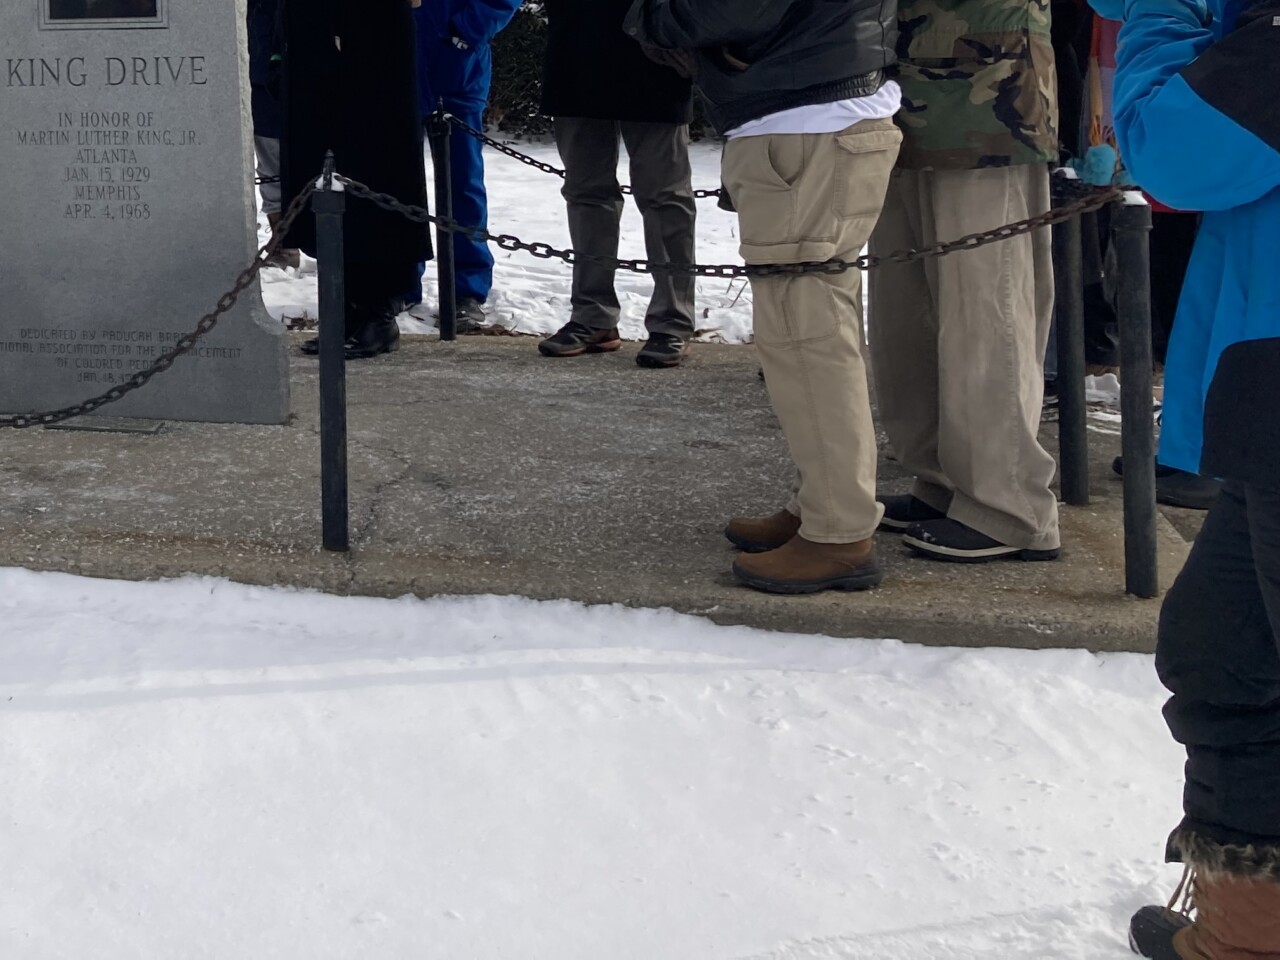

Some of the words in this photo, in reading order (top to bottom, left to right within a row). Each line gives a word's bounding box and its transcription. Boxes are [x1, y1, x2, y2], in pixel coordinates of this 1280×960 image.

[6, 57, 88, 87] KING
[104, 56, 208, 86] DRIVE
[58, 111, 73, 127] IN
[80, 111, 131, 128] HONOR
[136, 111, 154, 127] OF
[17, 130, 70, 145] MARTIN
[77, 130, 130, 145] LUTHER
[137, 130, 175, 146] KING,
[179, 130, 201, 145] JR.
[76, 148, 137, 163] ATLANTA
[63, 166, 93, 182] JAN.
[121, 166, 151, 182] 1929
[74, 185, 141, 200] MEMPHIS
[64, 203, 96, 219] APR.
[120, 203, 151, 219] 1968
[20, 328, 77, 340] DEDICATED
[82, 329, 97, 341] BY
[102, 330, 152, 342] PADUCAH
[39, 342, 107, 355] ASSOCIATION
[112, 344, 132, 356] FOR
[136, 345, 156, 357] THE
[55, 356, 68, 368] OF
[76, 358, 123, 370] COLORED
